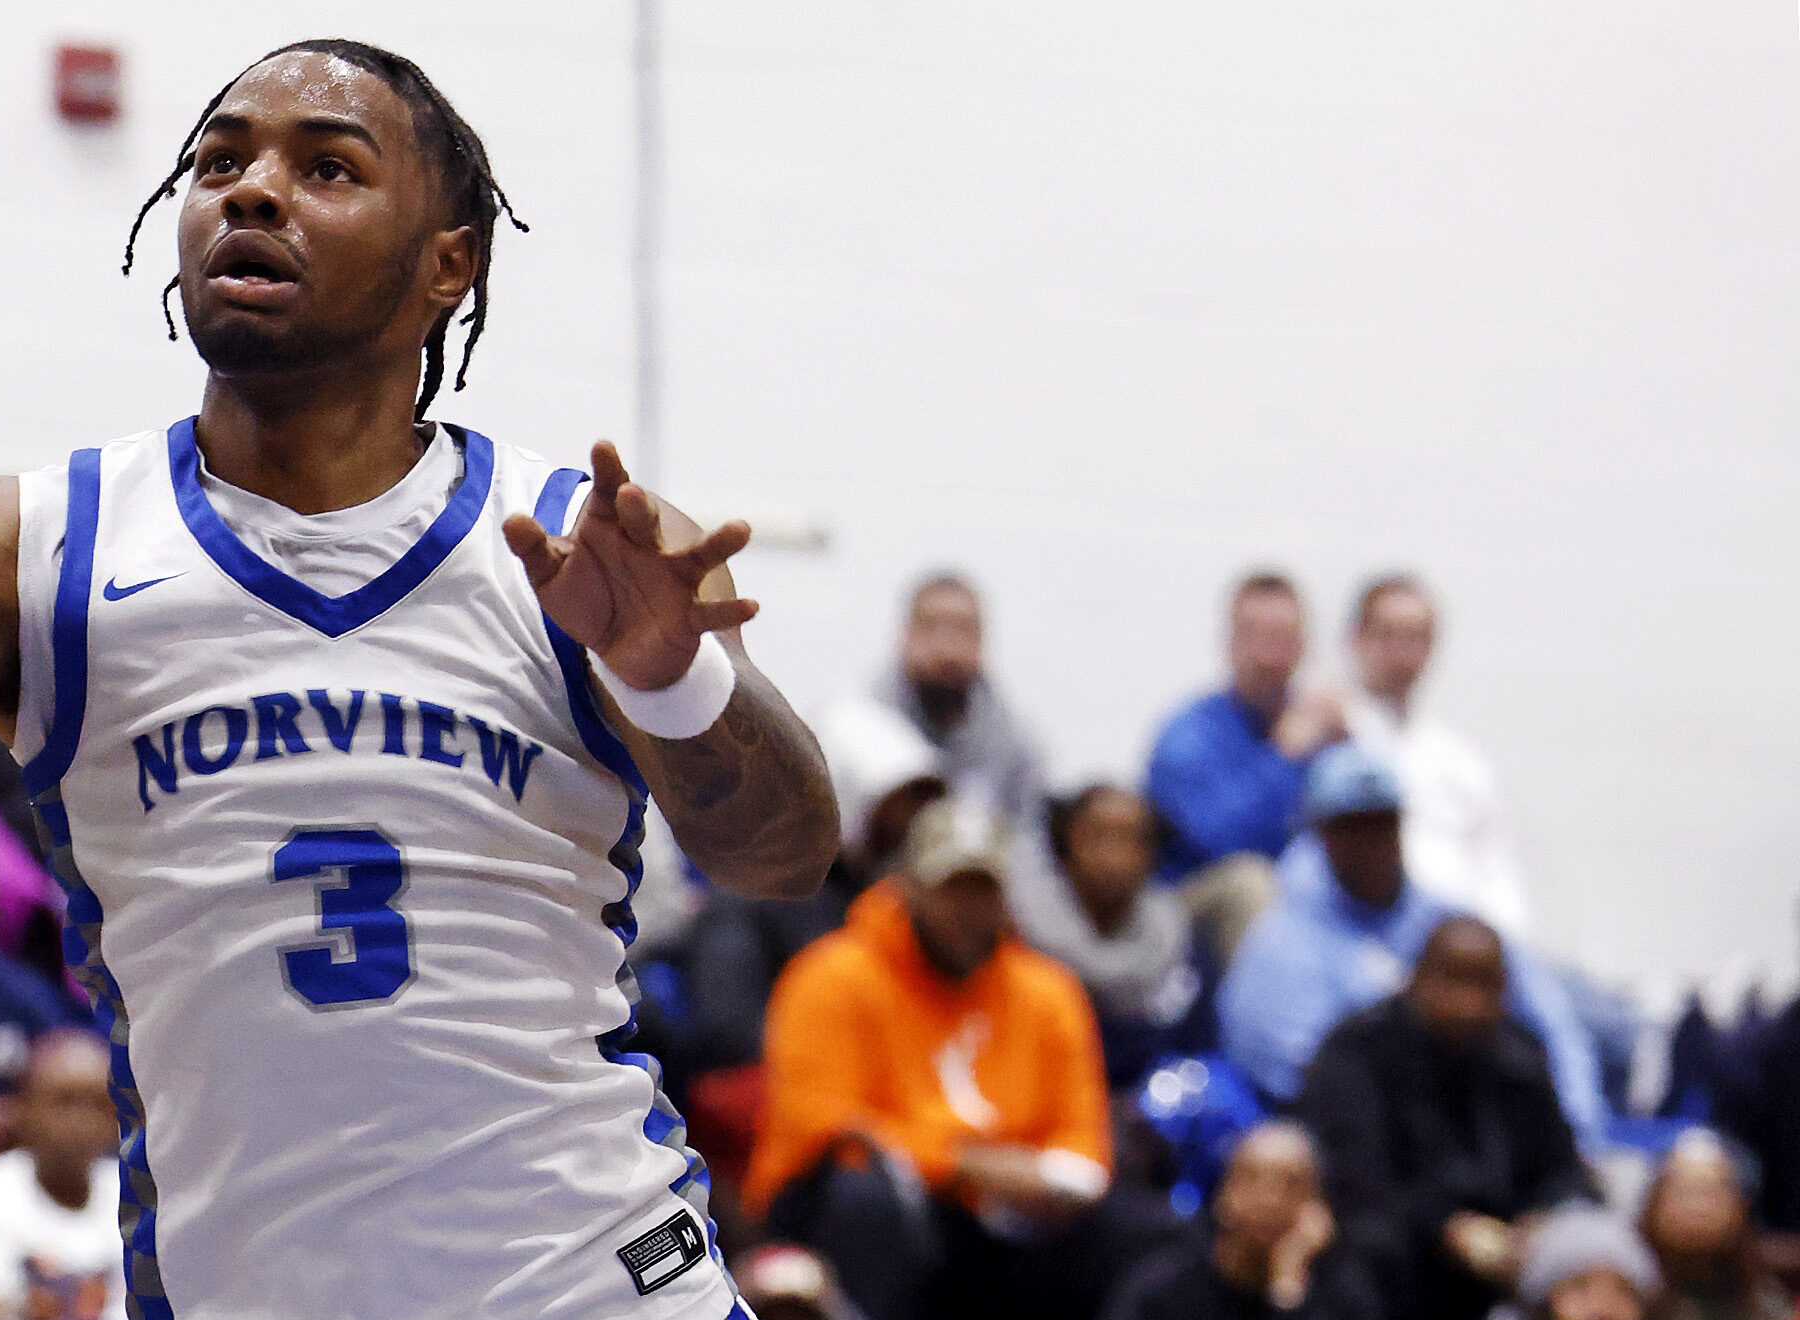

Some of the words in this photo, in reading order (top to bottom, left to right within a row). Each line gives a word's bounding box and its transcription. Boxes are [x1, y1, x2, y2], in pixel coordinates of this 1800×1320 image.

[132, 688, 543, 815] NORVIEW
[269, 822, 417, 1013] 3
[626, 1230, 671, 1260] ENGINEERED
[681, 1226, 698, 1250] M
